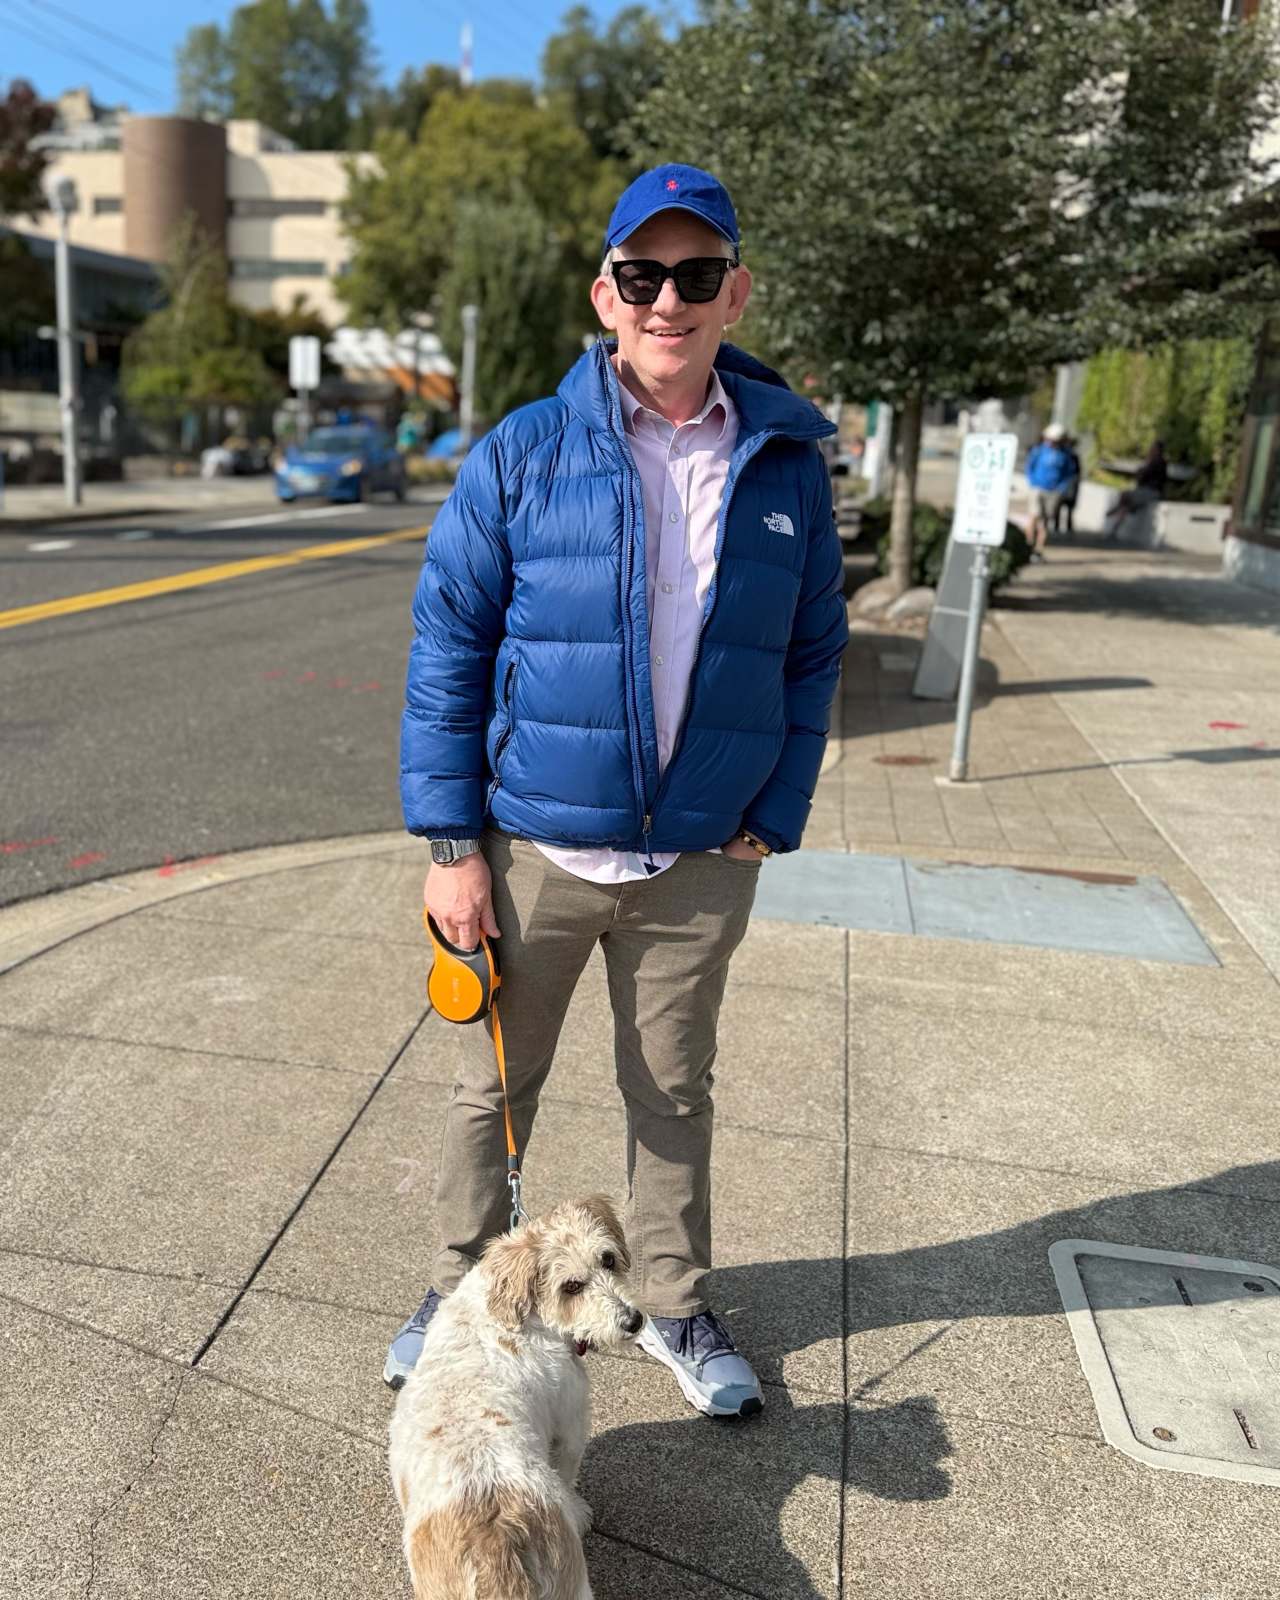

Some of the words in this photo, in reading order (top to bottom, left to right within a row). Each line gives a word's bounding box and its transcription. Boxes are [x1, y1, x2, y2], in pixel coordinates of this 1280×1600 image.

[772, 512, 784, 520] THE
[763, 516, 784, 526] NORTH
[768, 525, 784, 534] FACE
